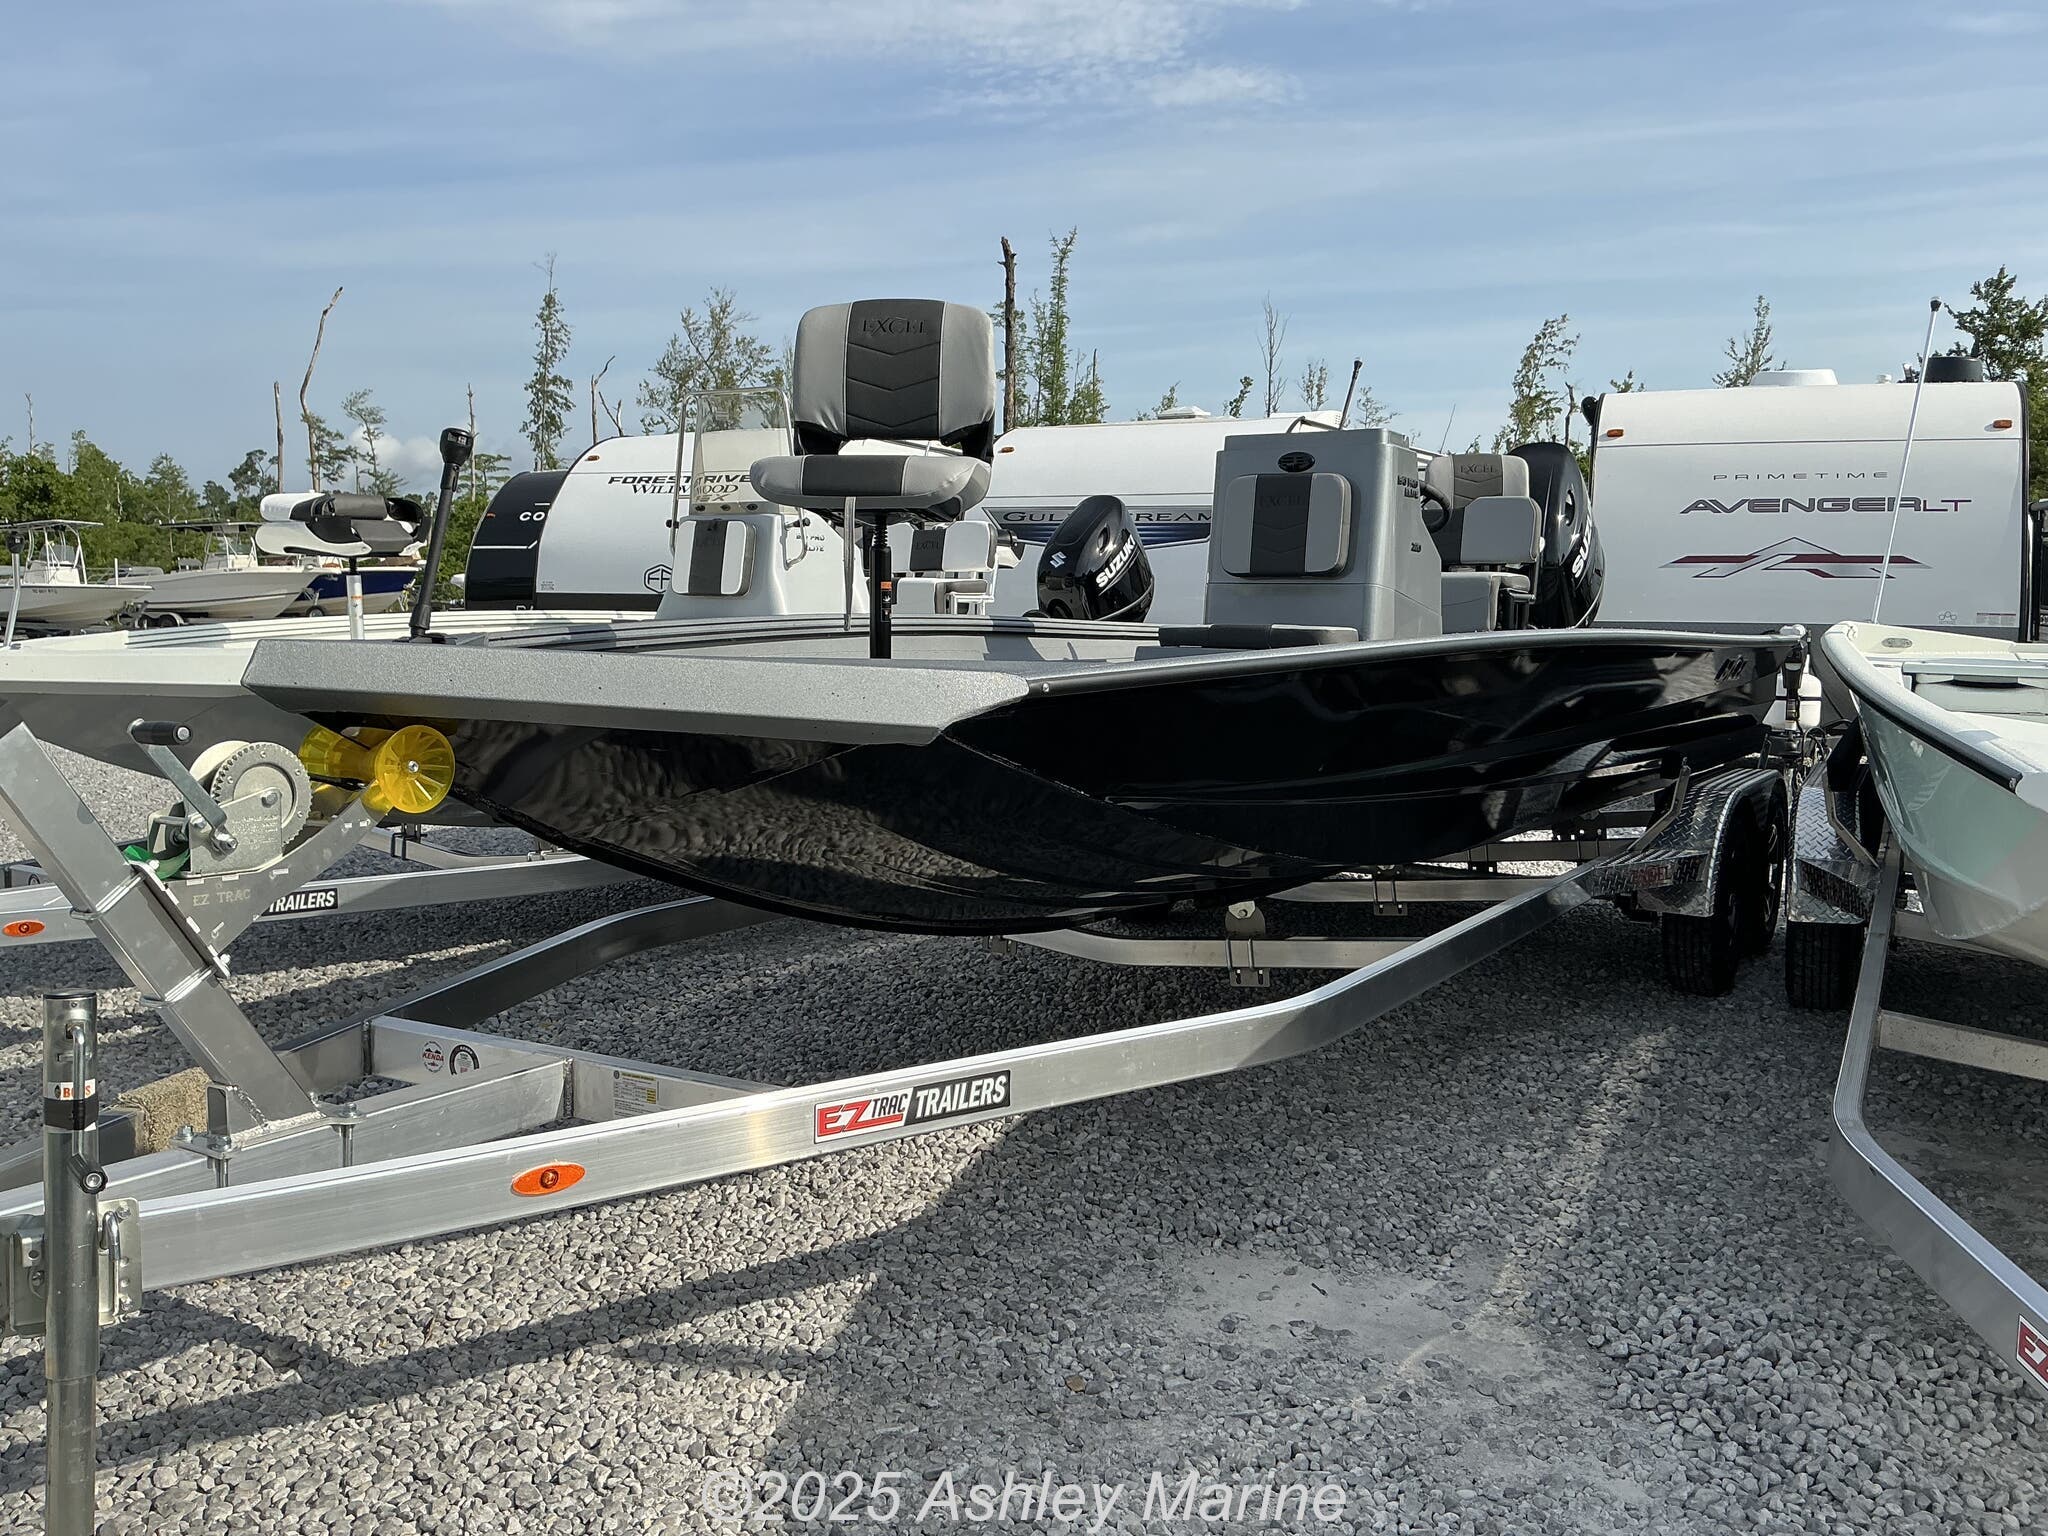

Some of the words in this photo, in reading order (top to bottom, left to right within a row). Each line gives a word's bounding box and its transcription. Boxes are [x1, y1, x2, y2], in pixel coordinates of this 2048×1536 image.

[1459, 463, 1498, 473] EXCEL
[704, 475, 751, 484] RIVE
[1713, 472, 1888, 480] PRIMETIME
[1680, 497, 1921, 514] AVENGER
[1923, 499, 1972, 512] LT
[1003, 511, 1068, 522] GUL
[1096, 534, 1135, 588] SUZUKI
[192, 893, 210, 906] EZ
[216, 888, 252, 903] TRAC
[269, 891, 335, 912] TRAILERS
[422, 1051, 445, 1062] KENDA
[817, 1100, 904, 1137] EZ
[872, 1094, 908, 1117] TRAC
[915, 1075, 1006, 1119] TRAILERS
